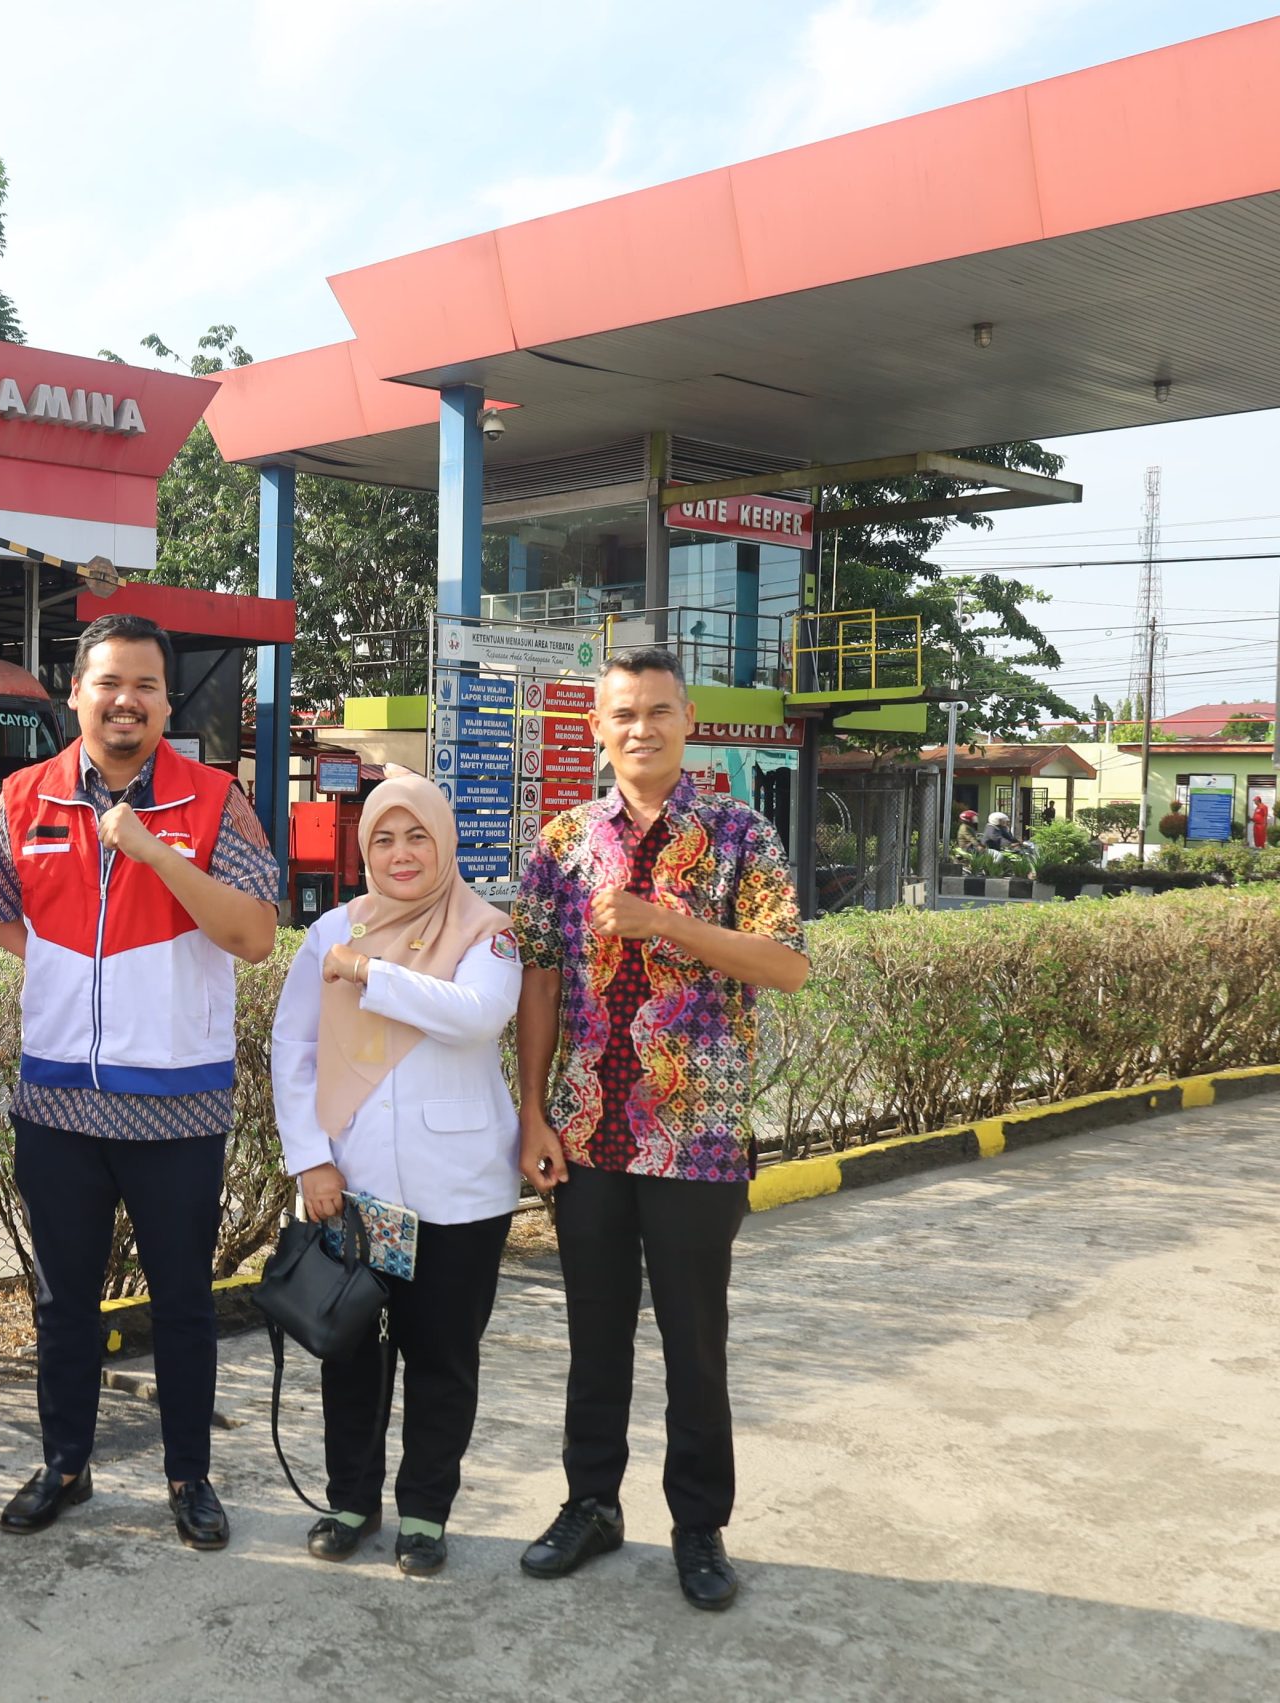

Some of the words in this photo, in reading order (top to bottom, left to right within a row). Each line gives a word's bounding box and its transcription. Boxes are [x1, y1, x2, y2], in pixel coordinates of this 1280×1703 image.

[682, 499, 728, 523] GATE
[740, 504, 803, 536] KEEPER
[472, 633, 504, 645] KETENTUAN
[505, 636, 534, 648] MEMASUKI
[534, 639, 548, 649] AREA
[549, 641, 574, 652] TERBATAS
[469, 684, 486, 693] TAMU
[486, 686, 507, 694] WAJIB
[461, 693, 483, 702] LAPOR
[483, 694, 512, 704] SECURITY
[556, 690, 586, 699] DILARANG
[546, 698, 585, 708] MENYALAKAN
[465, 719, 483, 727] WAJIB
[483, 719, 508, 728] MEMAKAI
[554, 724, 584, 732] DILARANG
[698, 722, 796, 739] ECURITY
[554, 732, 584, 741] MEROKOK
[460, 752, 480, 760] WAJIB
[481, 753, 510, 762] MEMAKAI
[460, 761, 484, 769] SAFETY
[484, 762, 509, 771] HELMET
[458, 820, 479, 828] WAJIB
[460, 829, 484, 837] SAFETY
[488, 855, 508, 863] MASUK
